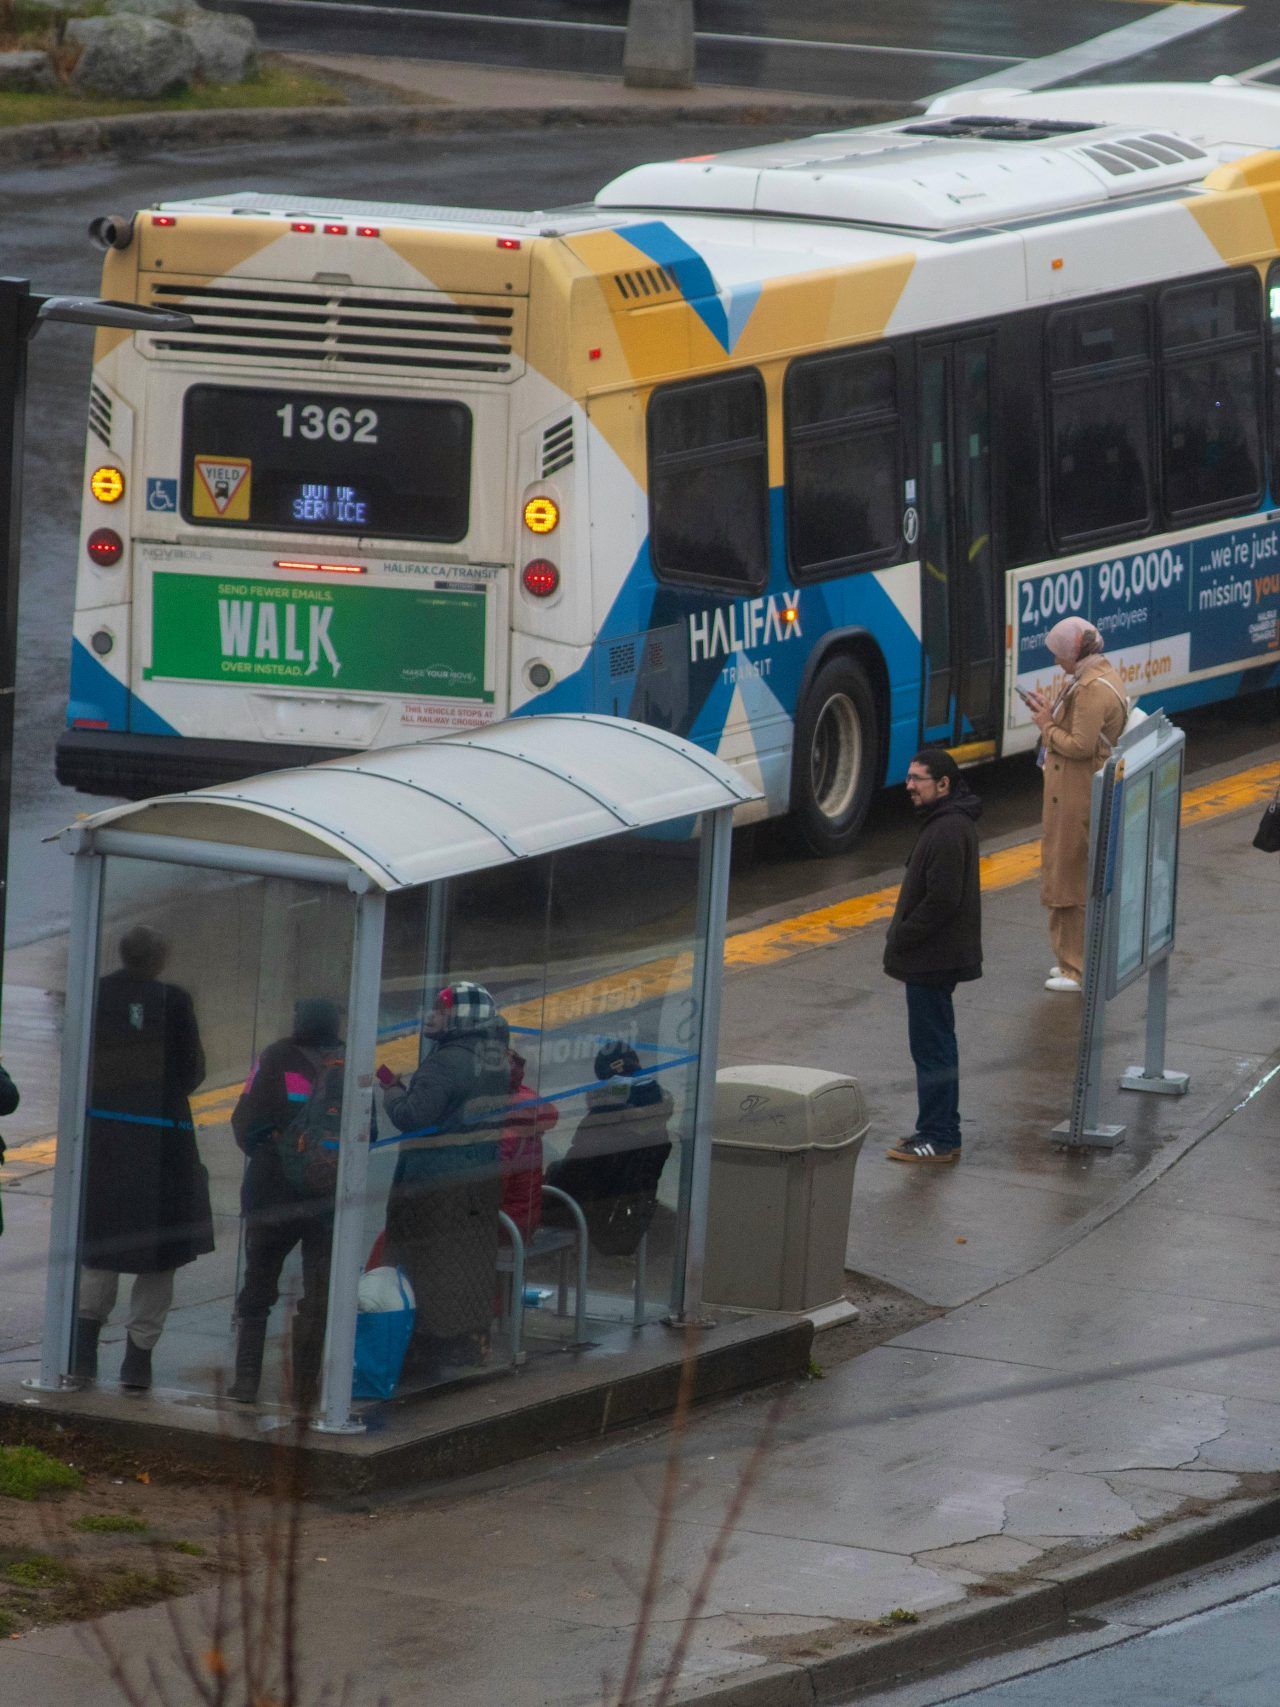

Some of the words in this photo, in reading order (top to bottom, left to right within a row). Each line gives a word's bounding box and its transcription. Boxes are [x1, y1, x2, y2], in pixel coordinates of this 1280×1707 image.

[276, 403, 379, 444] 1362
[205, 467, 241, 481] YIELD
[292, 500, 368, 523] SERVICE
[1200, 535, 1249, 572] ...we're
[1250, 531, 1279, 569] just
[383, 563, 499, 580] HALIFAX.CA/TRANSIT
[1098, 548, 1184, 603] 90,000+
[218, 583, 248, 596] SEND
[250, 586, 289, 598] FEWER
[292, 588, 333, 602] EMAILS.
[1021, 570, 1084, 626] 2,000
[1199, 575, 1252, 610] missing
[689, 589, 803, 663] HALIFAX
[1097, 605, 1148, 632] employees
[218, 599, 342, 678] WALK
[1020, 629, 1048, 652] mem
[221, 661, 252, 674] OVER
[254, 663, 303, 676] INSTEAD.
[722, 658, 773, 685] TRANSIT
[400, 715, 415, 723] ALL
[417, 716, 449, 726] RAILWAY
[405, 705, 422, 714] THIS
[424, 706, 456, 716] VEHICLE
[458, 708, 482, 718] STOPS
[484, 710, 494, 718] AT
